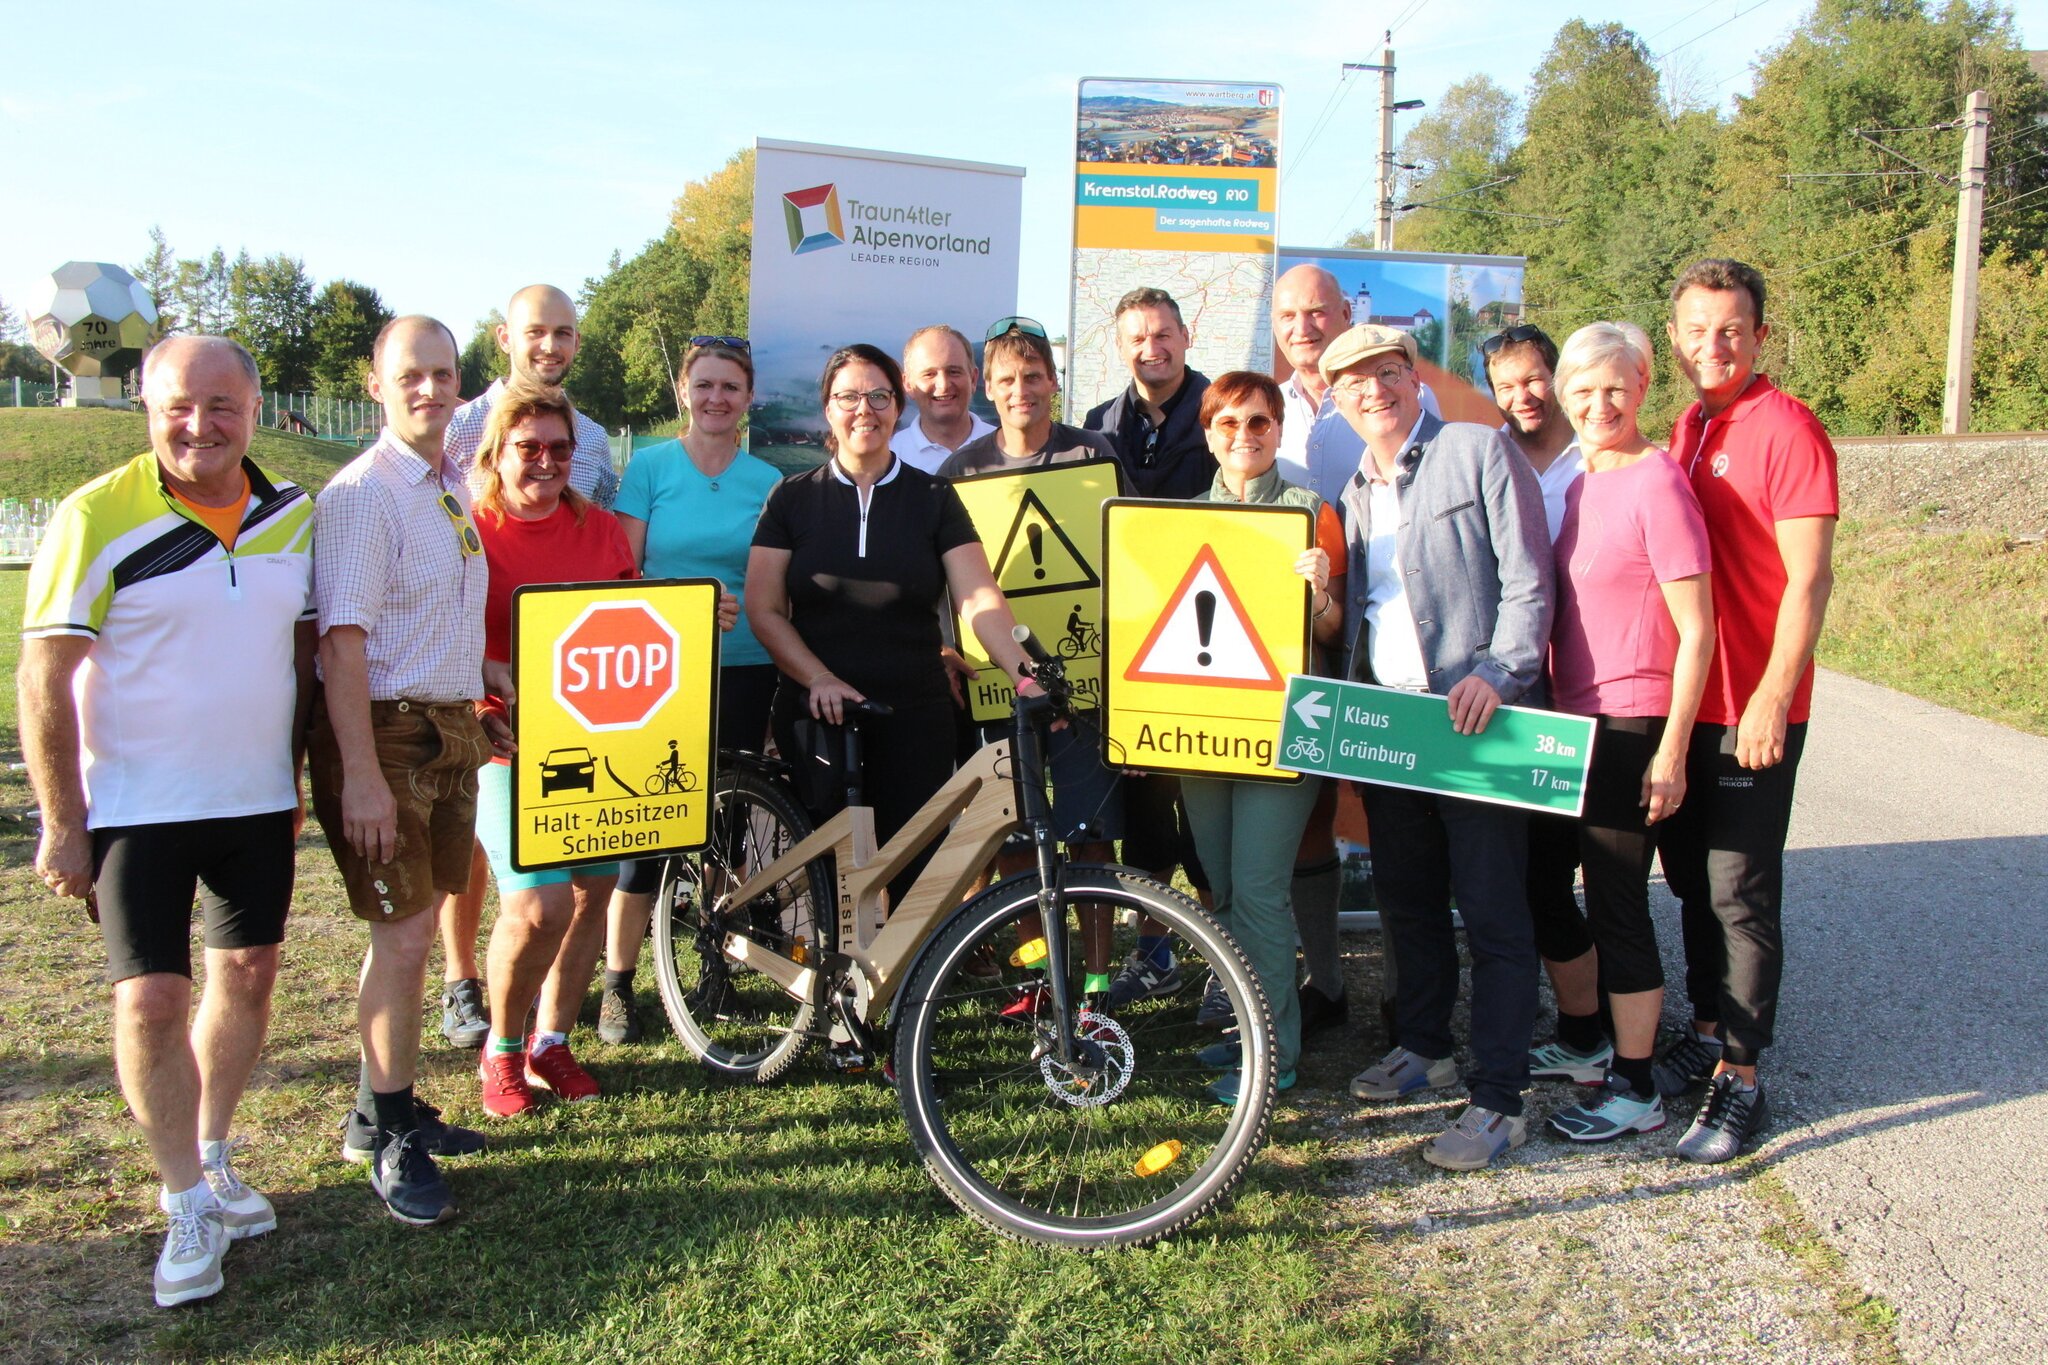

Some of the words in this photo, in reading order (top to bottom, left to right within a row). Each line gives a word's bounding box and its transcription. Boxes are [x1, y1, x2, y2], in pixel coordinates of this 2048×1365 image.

[1185, 90, 1254, 99] www.wartberg.at
[1084, 182, 1218, 205] Kremstal.Radweg
[1225, 189, 1249, 201] R10
[847, 199, 952, 227] Traun4tler
[1160, 216, 1177, 225] Der
[1178, 217, 1231, 229] sagenhafte
[1233, 216, 1270, 230] Radweg
[852, 225, 991, 255] Alpenvorland
[851, 253, 895, 265] LEADER
[899, 256, 940, 267] REGION
[82, 321, 108, 336] 70
[566, 643, 668, 692] STOP
[1344, 705, 1389, 729] Klaus
[1136, 723, 1273, 767] Achtung
[1339, 739, 1417, 771] Grünburg
[1534, 734, 1555, 754] 38
[1556, 741, 1576, 758] km
[1530, 768, 1549, 787] 17
[1551, 776, 1570, 792] km
[562, 829, 660, 855] Schieben
